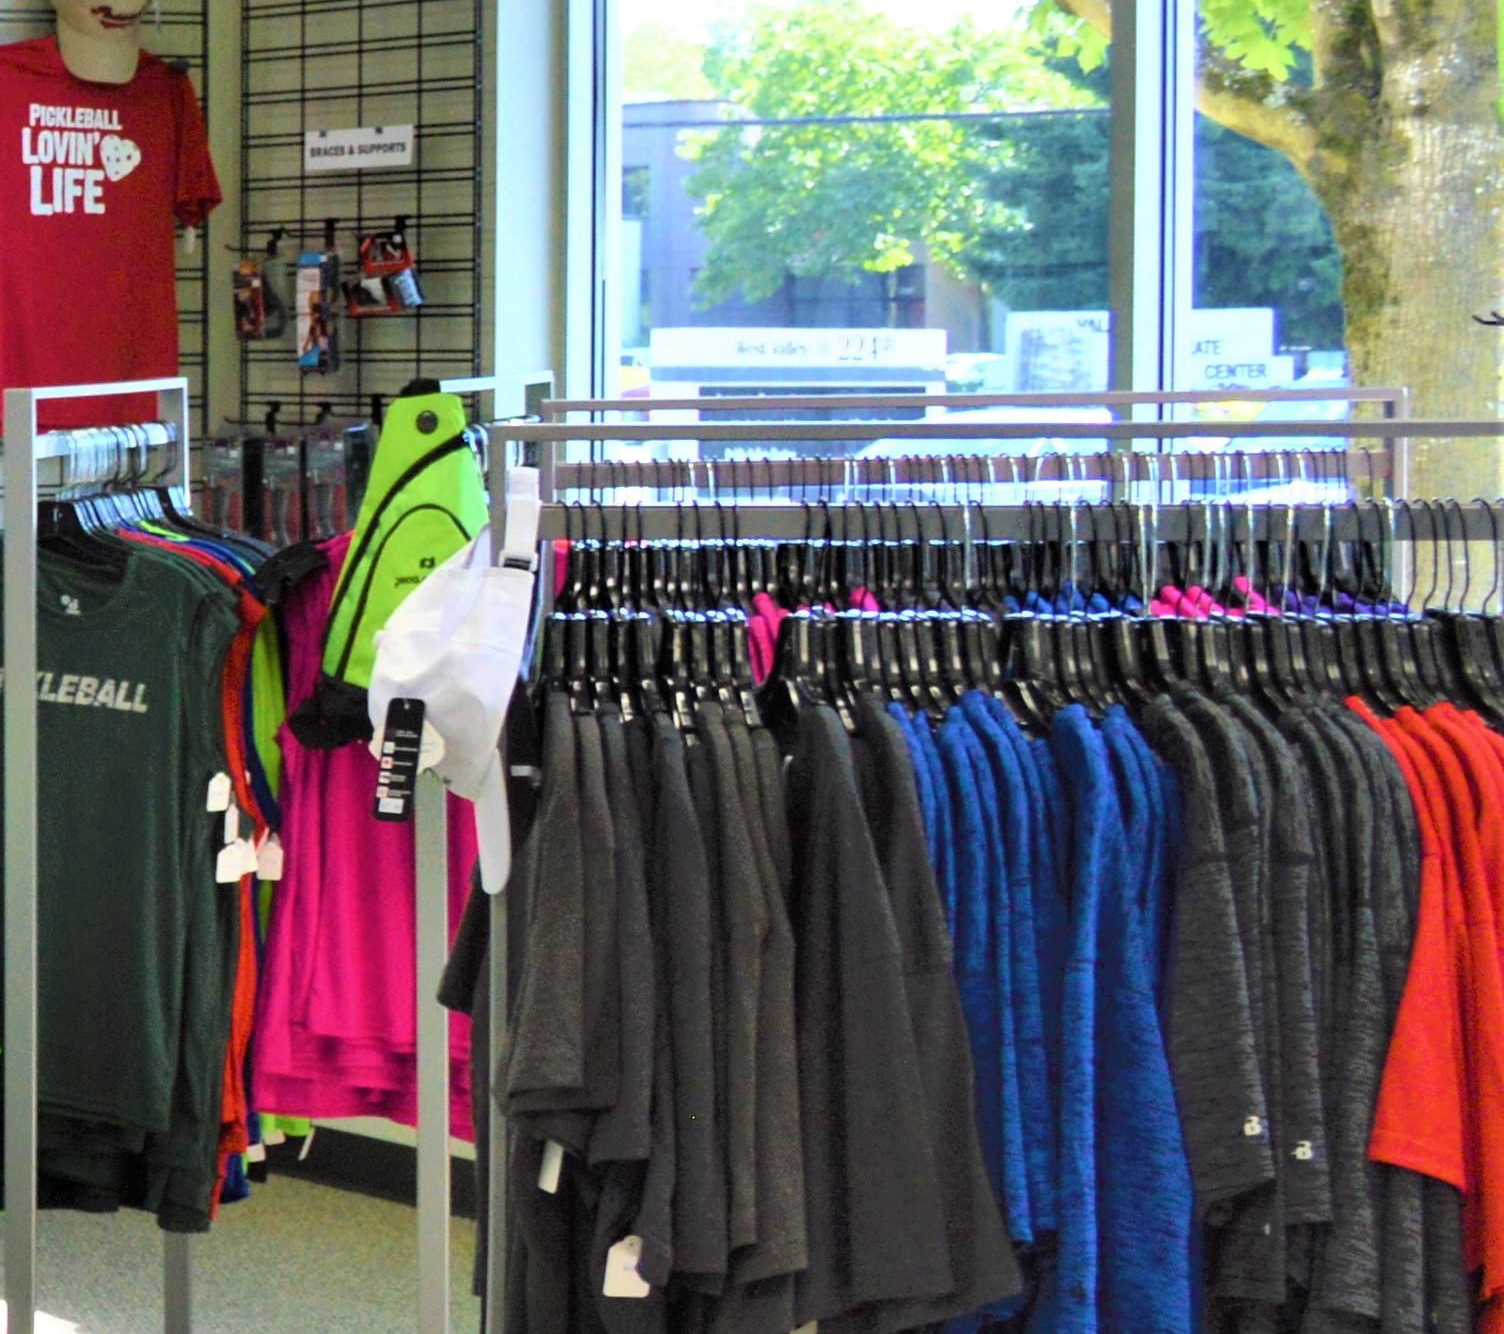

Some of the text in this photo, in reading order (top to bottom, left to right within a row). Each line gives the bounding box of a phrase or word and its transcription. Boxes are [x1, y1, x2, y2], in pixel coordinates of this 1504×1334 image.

[29, 104, 122, 130] PICKLEBALL
[22, 127, 101, 165] LOVIN'
[310, 144, 345, 159] BRACES
[358, 141, 407, 155] SUPPORTS
[30, 169, 106, 215] LIFE
